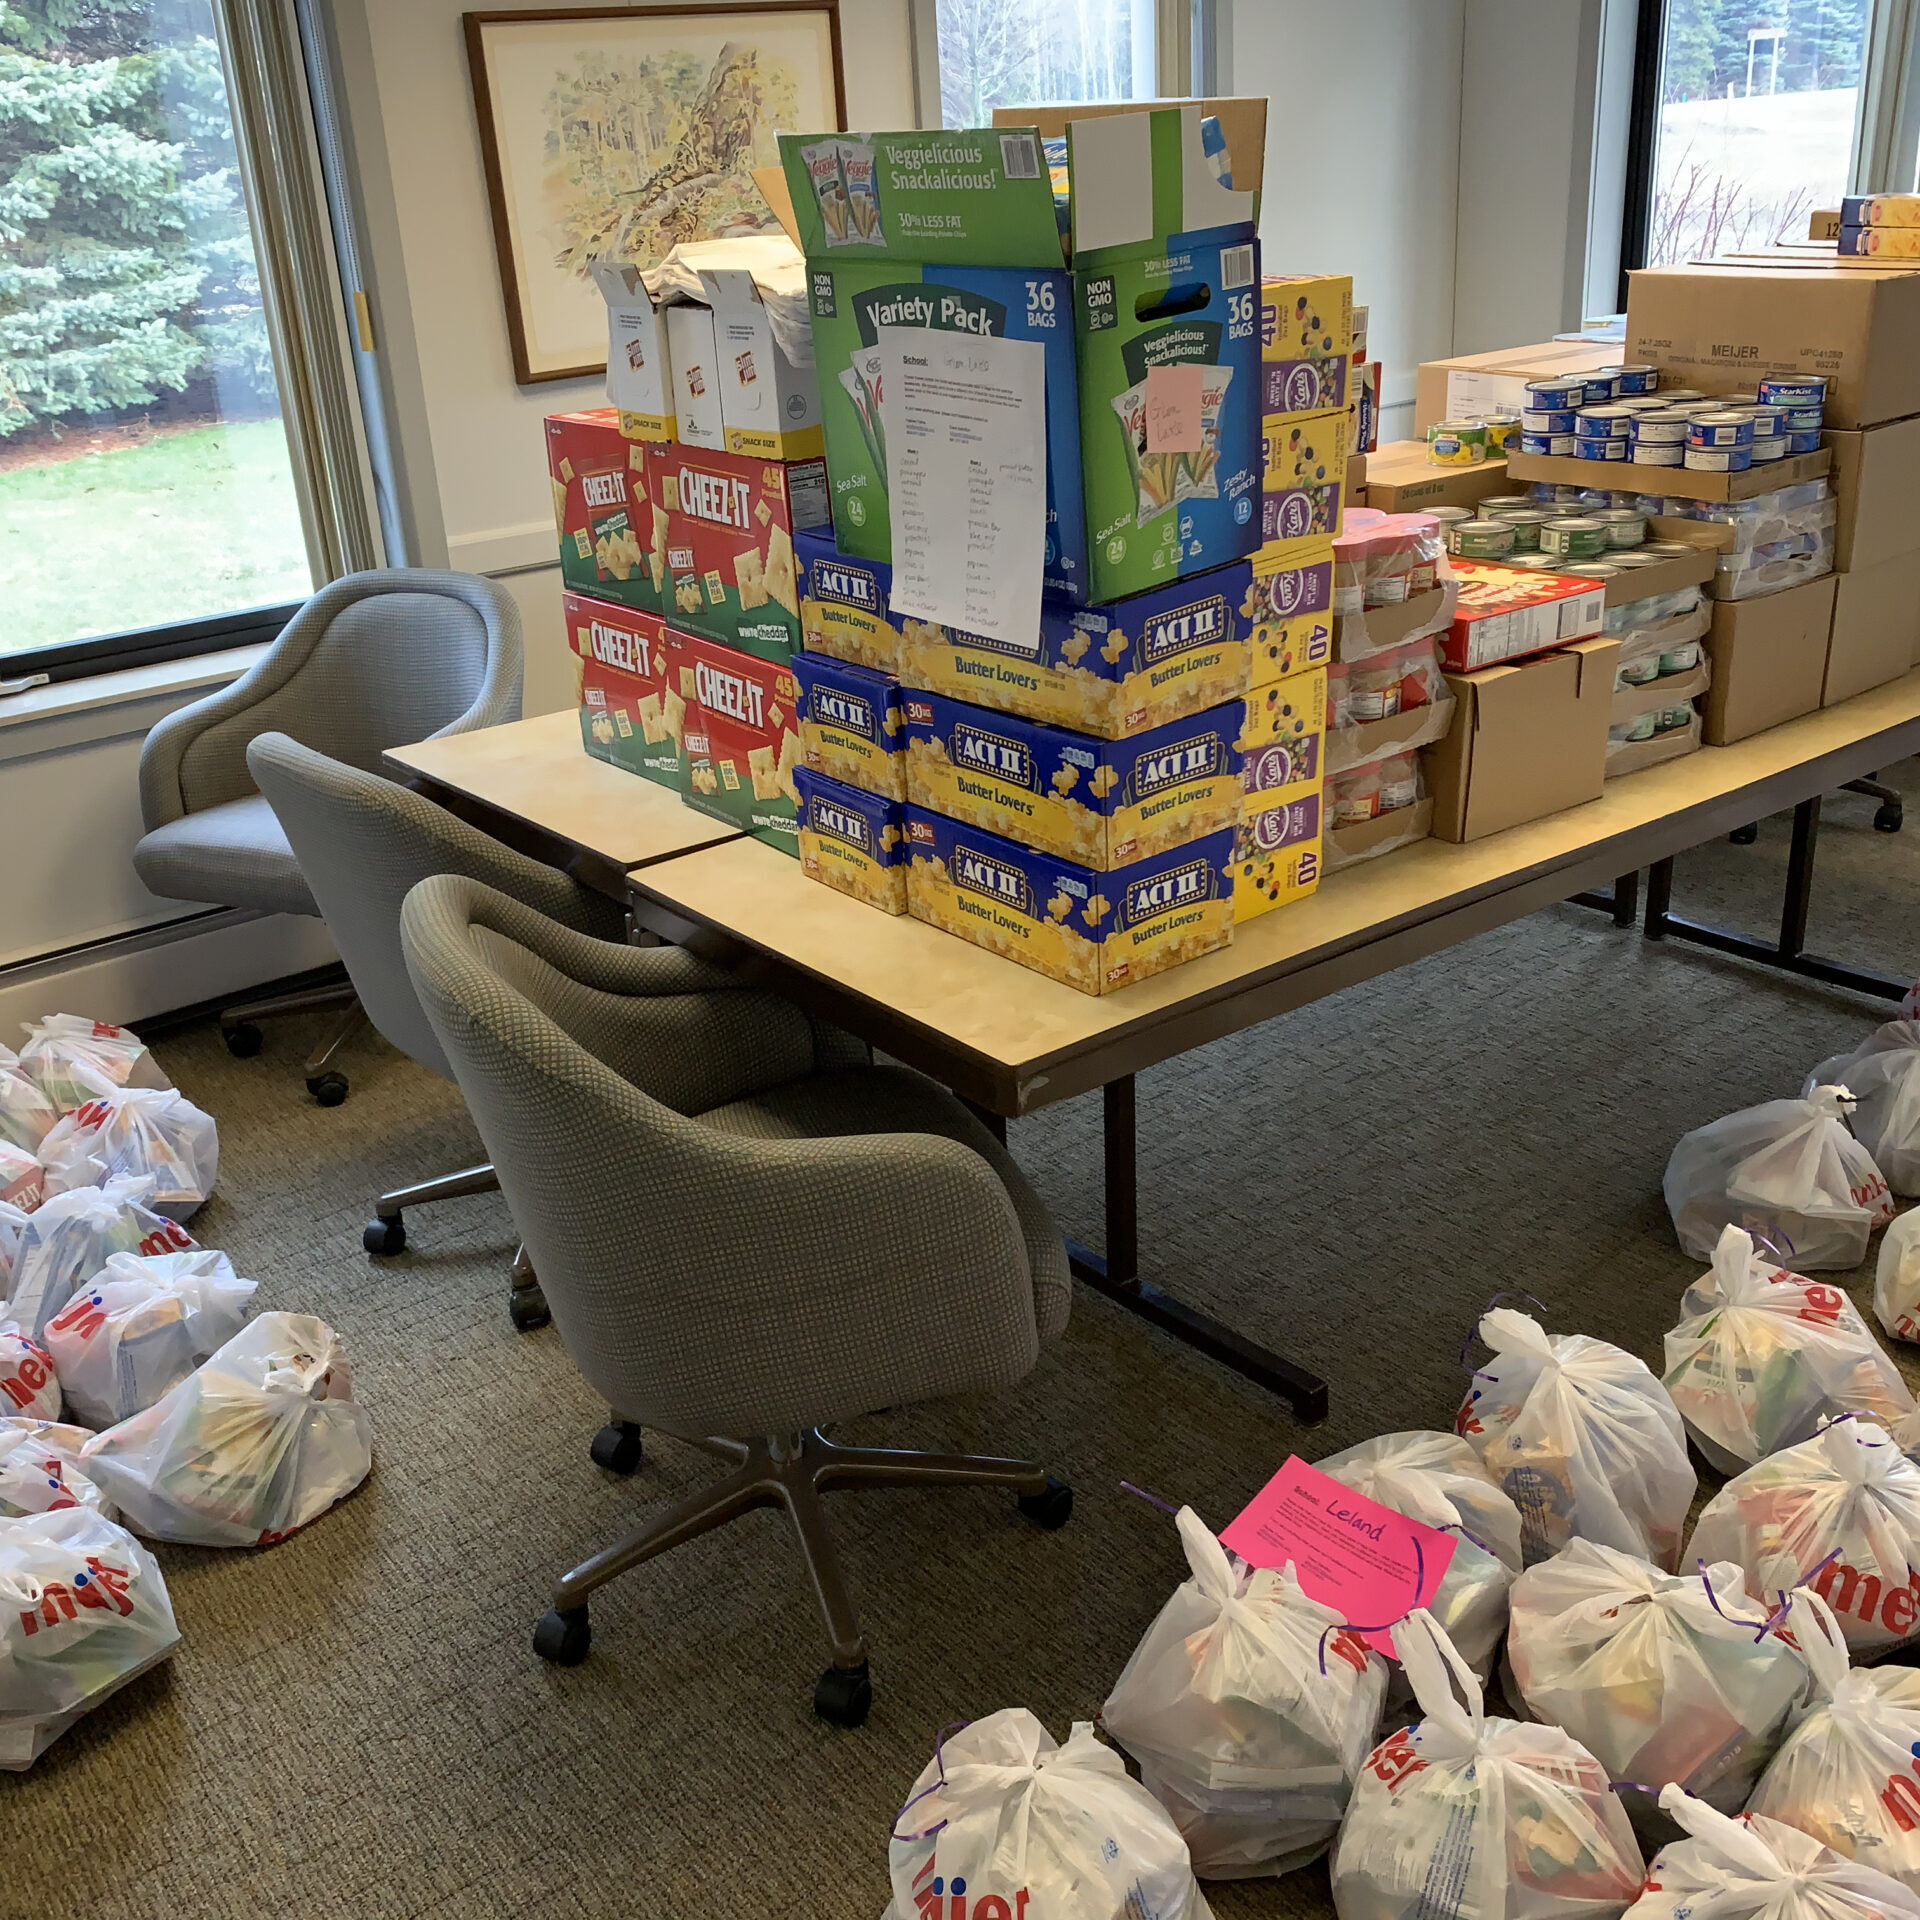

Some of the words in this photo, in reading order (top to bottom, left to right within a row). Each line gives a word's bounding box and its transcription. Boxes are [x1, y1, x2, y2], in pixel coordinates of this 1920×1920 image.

[885, 142, 982, 170] Veggielicious
[890, 168, 997, 191] Snackalicious!
[898, 213, 921, 228] 30%
[922, 215, 944, 229] LESS
[945, 216, 962, 229] FAT
[1144, 260, 1162, 272] 30%
[1162, 257, 1179, 269] LESS
[1179, 254, 1191, 266] FAT
[813, 274, 831, 285] NON
[814, 284, 833, 297] GMO
[1086, 280, 1112, 296] NON
[1025, 281, 1056, 311] 36
[1087, 292, 1113, 308] GMO
[1227, 293, 1255, 324] 36
[866, 295, 934, 329] Variety
[940, 298, 993, 337] Pack
[1027, 312, 1057, 329] BAGS
[1262, 304, 1277, 347] 40
[1143, 329, 1205, 353] Veggielicious
[1228, 322, 1254, 340] BAGS
[902, 355, 929, 367] School:
[1143, 344, 1208, 368] Snackalicious!
[1711, 344, 1759, 360] MEIJER
[1294, 371, 1307, 409] Kar's
[742, 436, 762, 446] SNACK
[762, 439, 776, 449] SIZE
[761, 465, 781, 490] 45
[836, 478, 851, 494] Sea
[850, 474, 868, 490] Salt
[1223, 467, 1248, 493] Zesty
[1228, 474, 1257, 502] Ranch
[849, 501, 863, 516] 24
[1238, 501, 1249, 514] 12
[1286, 500, 1299, 536] Kar's
[1096, 525, 1114, 545] Sea
[1114, 512, 1132, 532] Salt
[1109, 541, 1123, 555] 24
[820, 571, 850, 595] ACT
[852, 577, 870, 600] II
[1283, 573, 1295, 608] Kar's
[821, 608, 848, 625] Butter
[849, 612, 876, 634] Lovers
[1153, 616, 1191, 651] ACT
[1193, 607, 1216, 636] II
[807, 632, 816, 642] 30
[1308, 624, 1328, 661] 40
[954, 655, 995, 680] Butter
[996, 664, 1038, 691] Lovers
[1150, 662, 1186, 688] Butter
[1187, 652, 1222, 674] Lovers
[775, 675, 793, 698] 45
[819, 695, 849, 719] ACT
[849, 703, 865, 726] II
[908, 703, 923, 719] 30
[1125, 712, 1139, 726] 30
[806, 751, 815, 762] 30
[820, 730, 846, 748] Butter
[846, 737, 871, 759] Lovers
[963, 736, 998, 767] ACT
[999, 748, 1022, 775] II
[658, 756, 679, 773] chedd
[1143, 750, 1184, 785] ACT
[1185, 743, 1209, 770] II
[1265, 754, 1278, 787] Kar's
[956, 775, 993, 800] Butter
[994, 787, 1034, 817] Lovers
[1140, 796, 1177, 821] Butter
[1177, 786, 1214, 806] Lovers
[818, 806, 845, 830] ACT
[846, 816, 863, 839] II
[910, 823, 925, 838] 30
[1268, 808, 1281, 842] Kar's
[805, 859, 814, 869] 30
[818, 840, 842, 859] Butter
[843, 848, 868, 872] Lovers
[1115, 845, 1128, 859] 30
[963, 858, 996, 889] ACT
[997, 870, 1018, 898] II
[1298, 852, 1317, 886] 40
[1135, 880, 1174, 912] ACT
[1176, 869, 1200, 896] II
[956, 895, 992, 920] Butter
[993, 908, 1030, 940] Lovers
[1132, 920, 1168, 946] Butter
[1168, 910, 1204, 931] Lovers
[1107, 969, 1120, 983] 30
[1324, 1499, 1387, 1543] Leland
